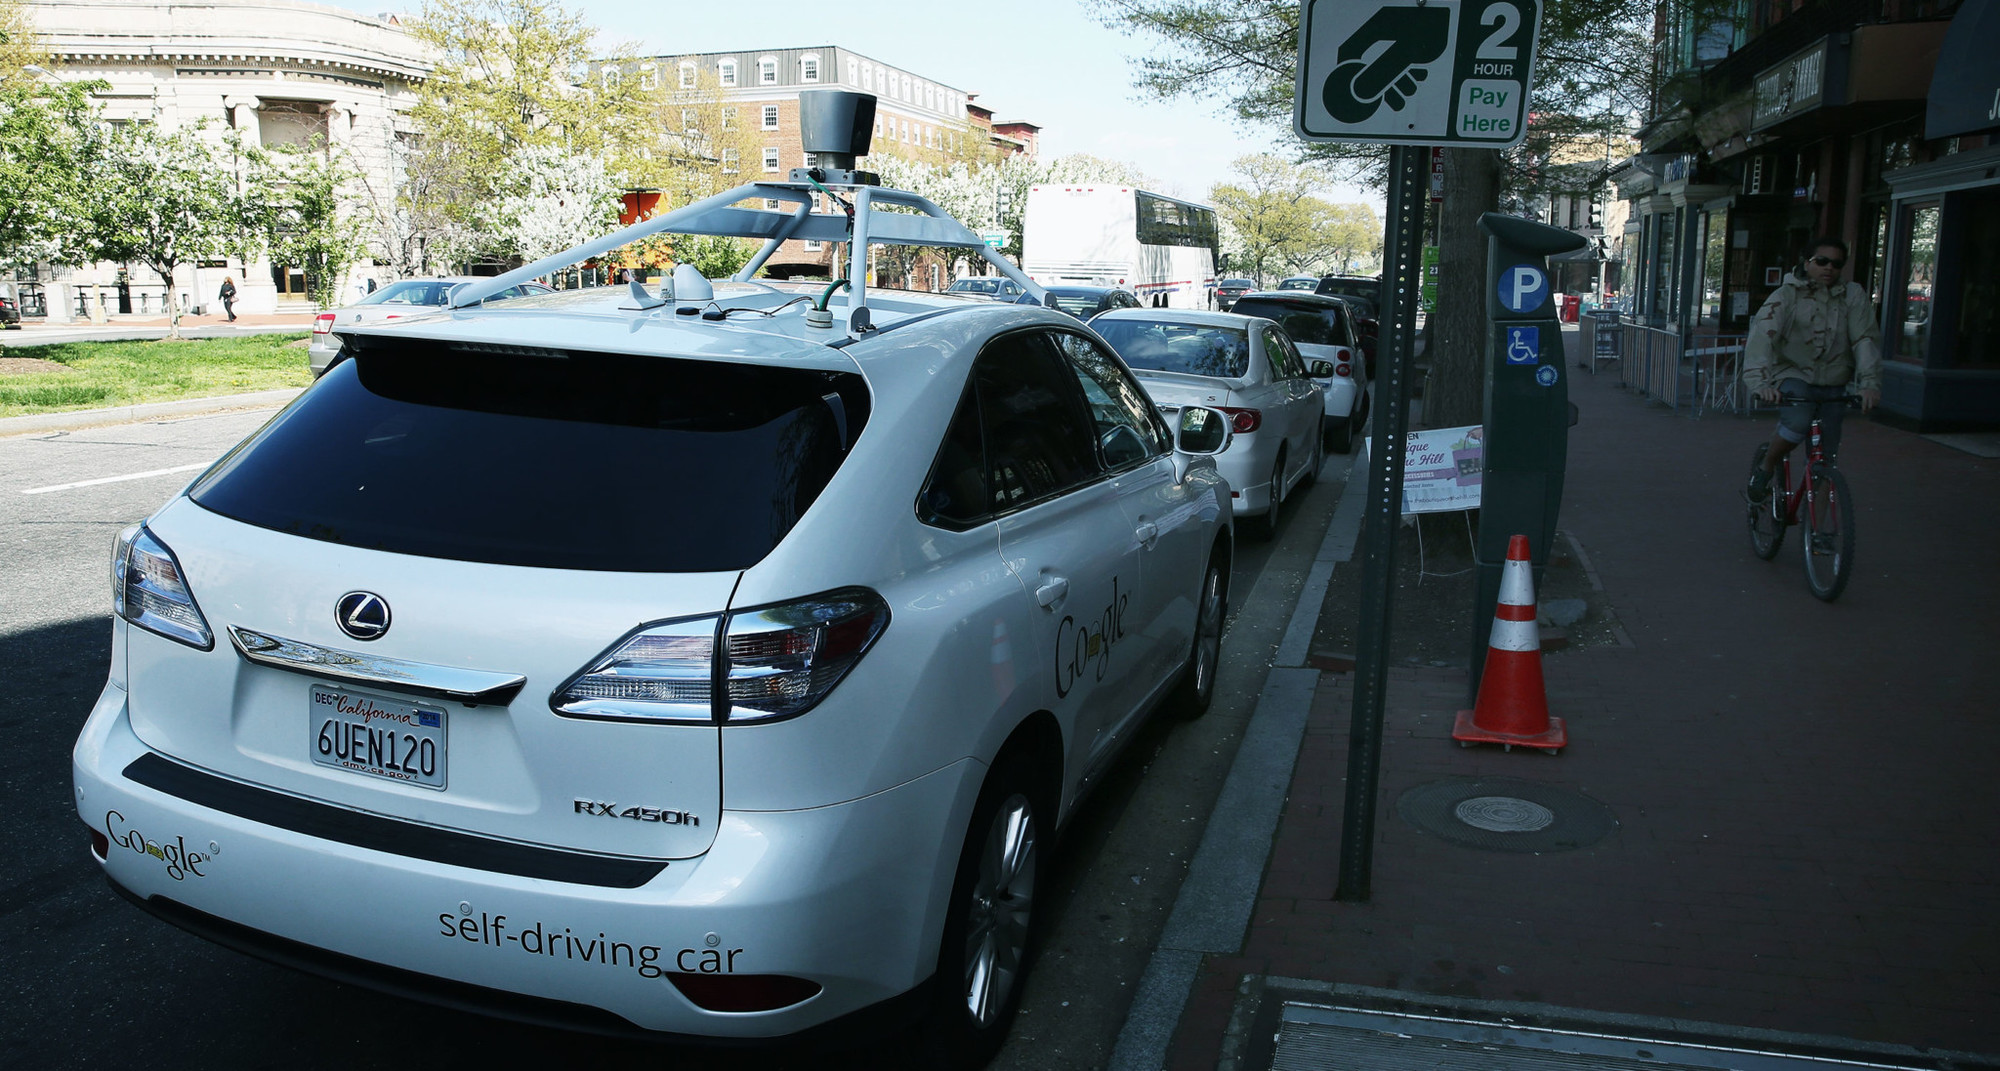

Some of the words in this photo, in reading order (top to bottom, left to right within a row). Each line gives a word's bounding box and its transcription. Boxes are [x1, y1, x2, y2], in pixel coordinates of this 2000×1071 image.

[1475, 2, 1521, 60] 2
[1473, 63, 1514, 77] HOUR
[1469, 86, 1509, 108] Pay
[1462, 114, 1511, 132] Here
[1512, 267, 1542, 310] P
[1418, 453, 1445, 465] Hill
[315, 692, 333, 706] DEC
[336, 695, 420, 727] California
[318, 719, 436, 777] 6UEN120
[342, 761, 412, 780] dmv.ca.gov
[573, 796, 700, 828] RX450h
[439, 912, 662, 979] self-driving
[676, 946, 744, 974] car
